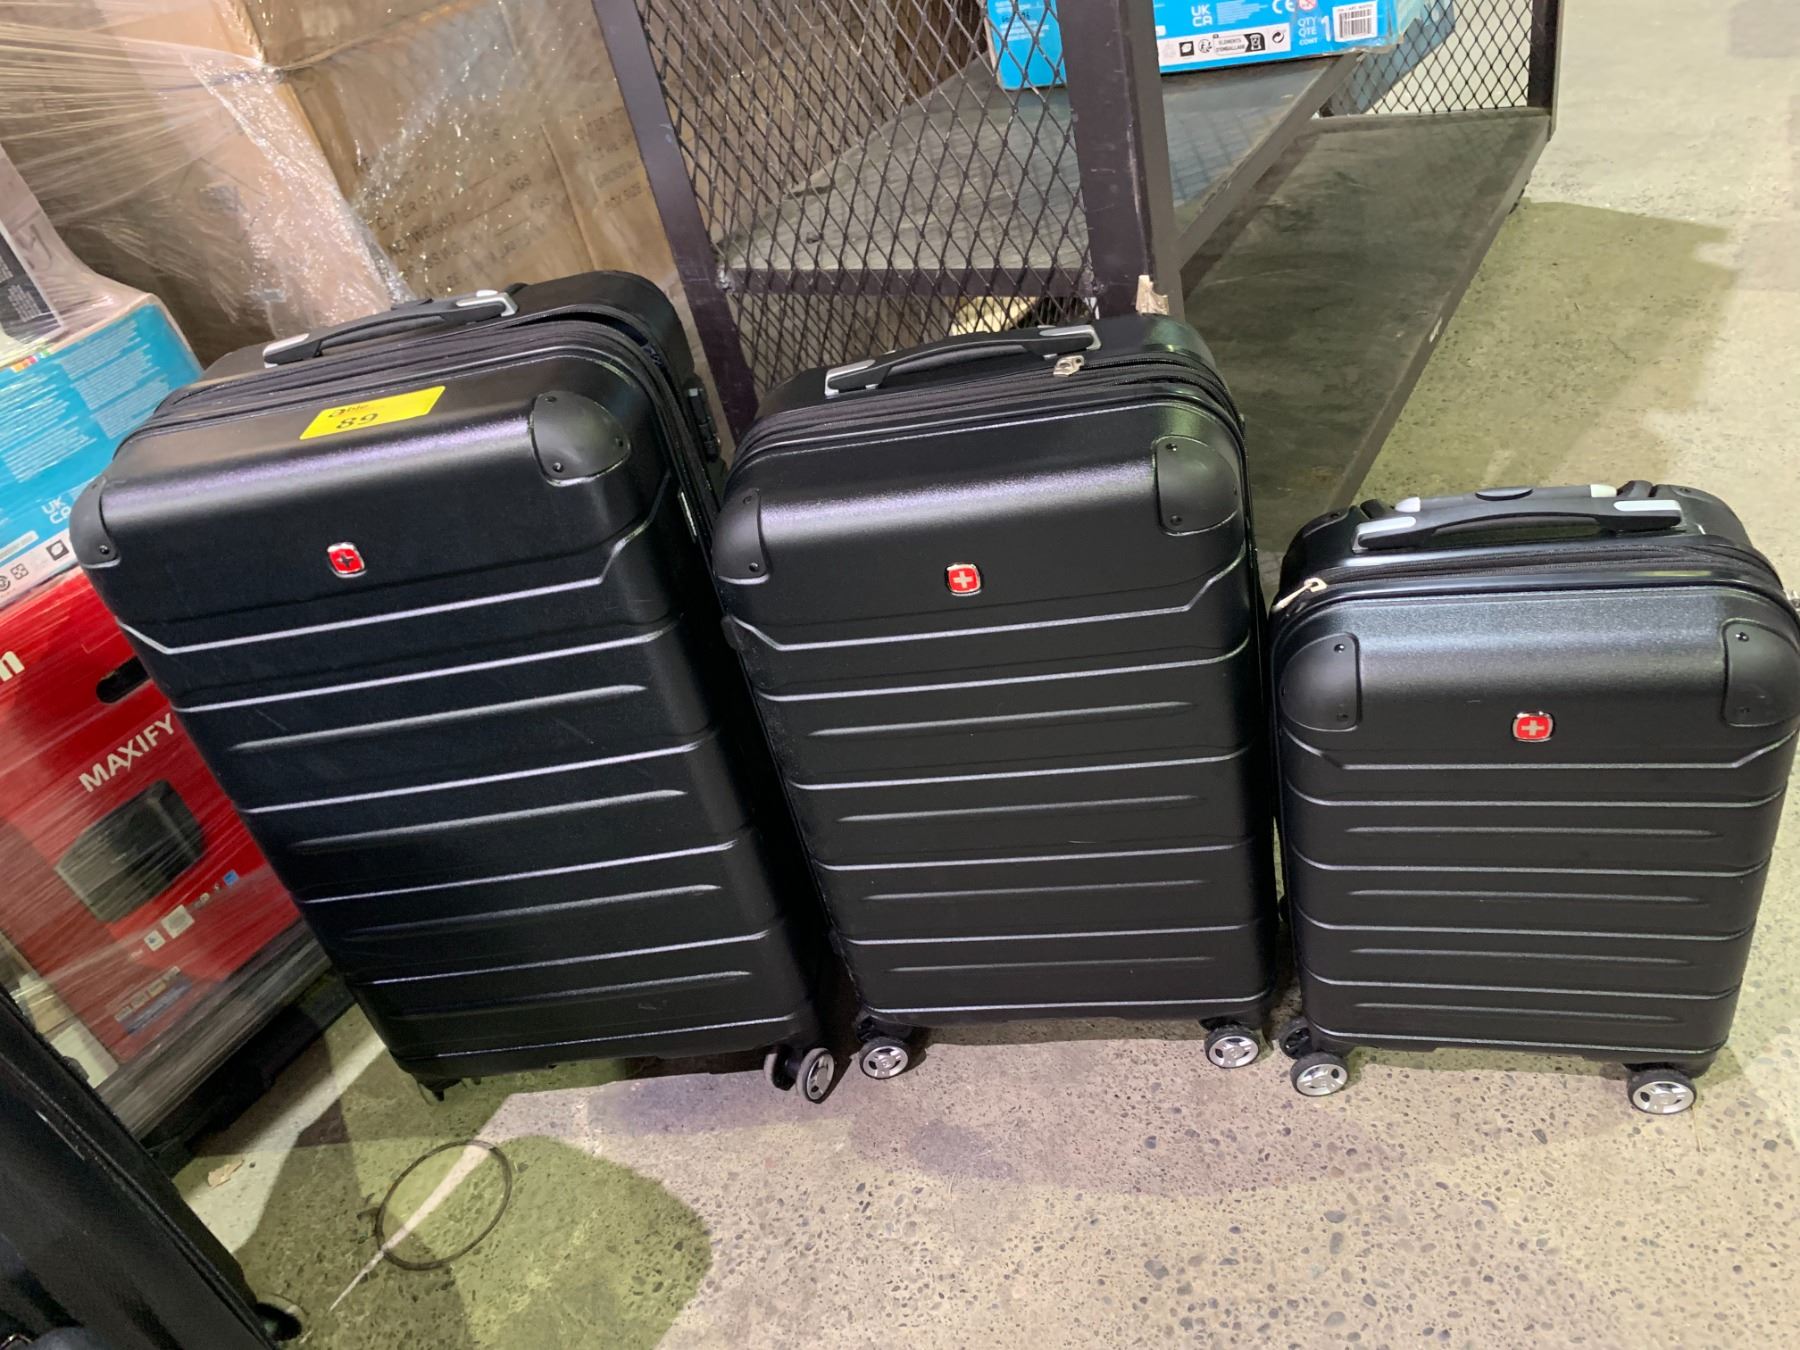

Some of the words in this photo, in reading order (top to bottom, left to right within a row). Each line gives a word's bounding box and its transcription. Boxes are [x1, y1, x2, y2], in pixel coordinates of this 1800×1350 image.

[1191, 4, 1210, 16] UK
[1192, 15, 1213, 27] CA
[1298, 16, 1317, 27] QTY
[1321, 15, 1331, 42] 1
[336, 413, 378, 429] 89
[41, 495, 67, 514] UK
[79, 713, 175, 793] MAXIFY
